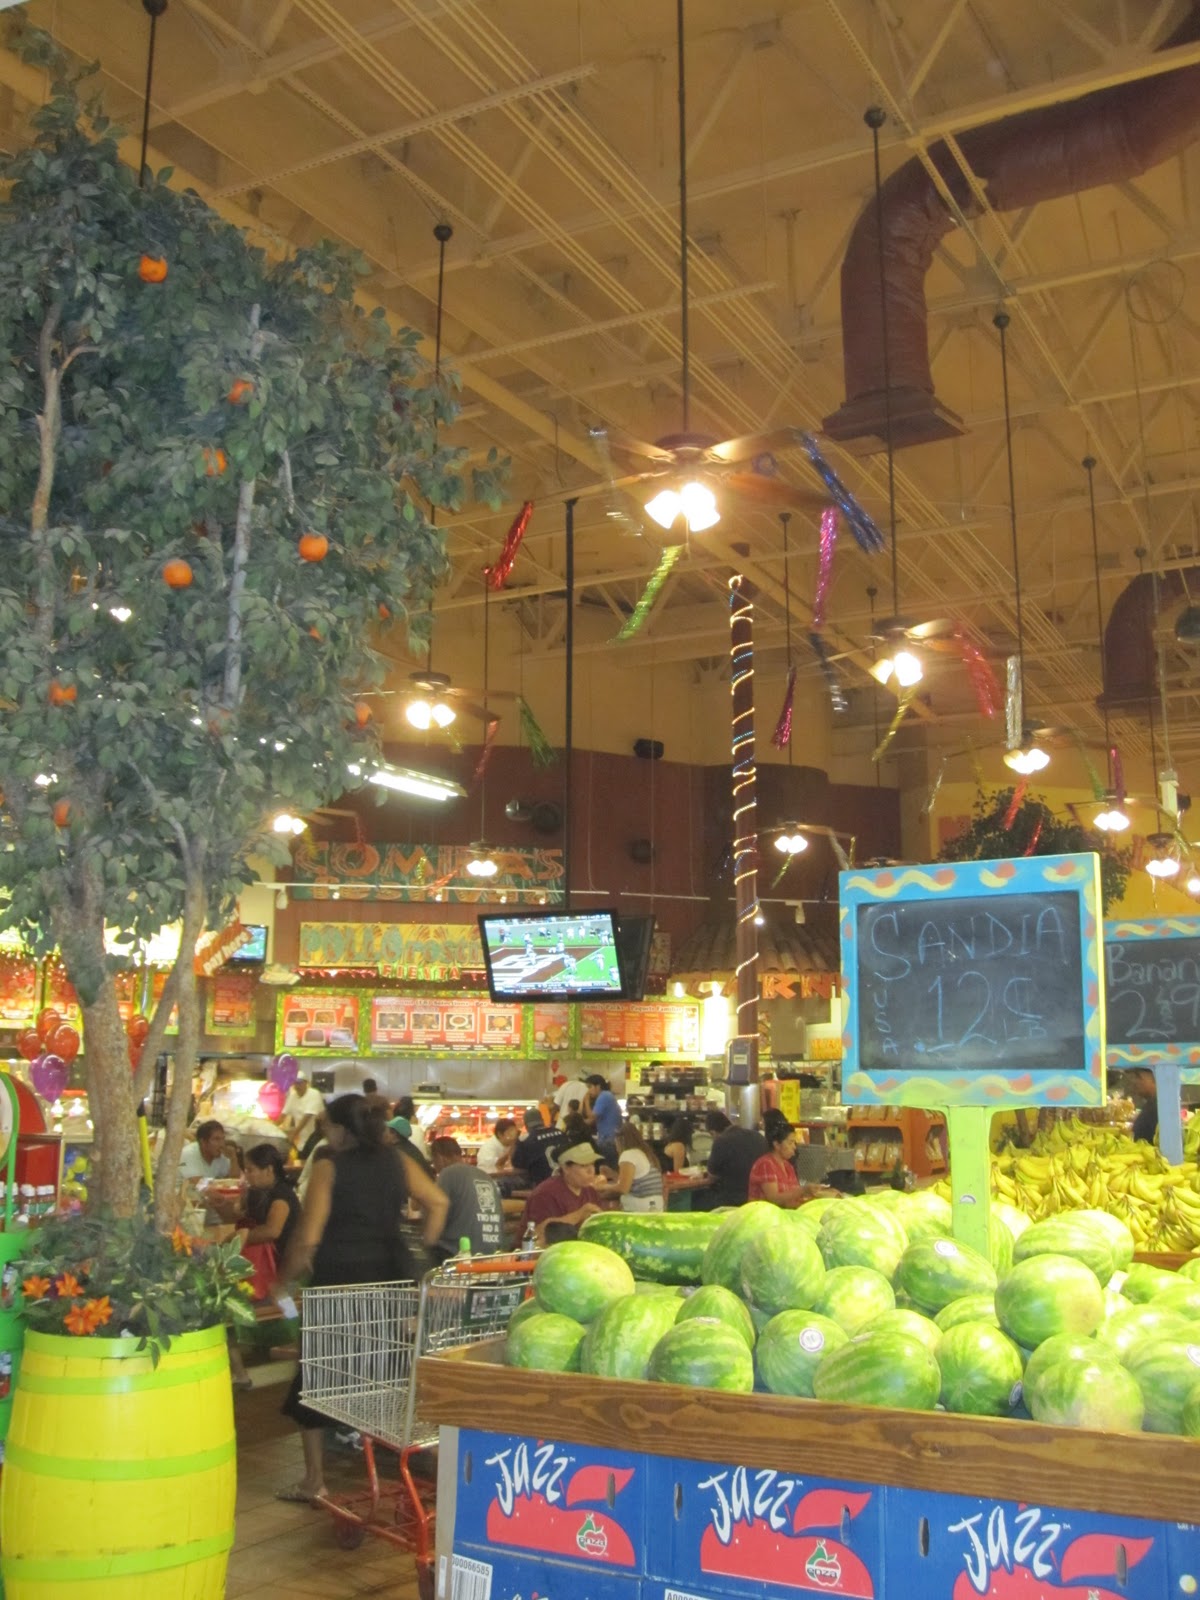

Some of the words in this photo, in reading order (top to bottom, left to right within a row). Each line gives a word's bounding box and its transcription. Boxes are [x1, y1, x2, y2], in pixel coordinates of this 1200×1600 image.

[871, 906, 1069, 981] SANDIA
[484, 1442, 569, 1516] JAZZ
[697, 1465, 795, 1544] JAZZ
[807, 1566, 838, 1579] enza
[947, 1505, 1061, 1593] JAZZ
